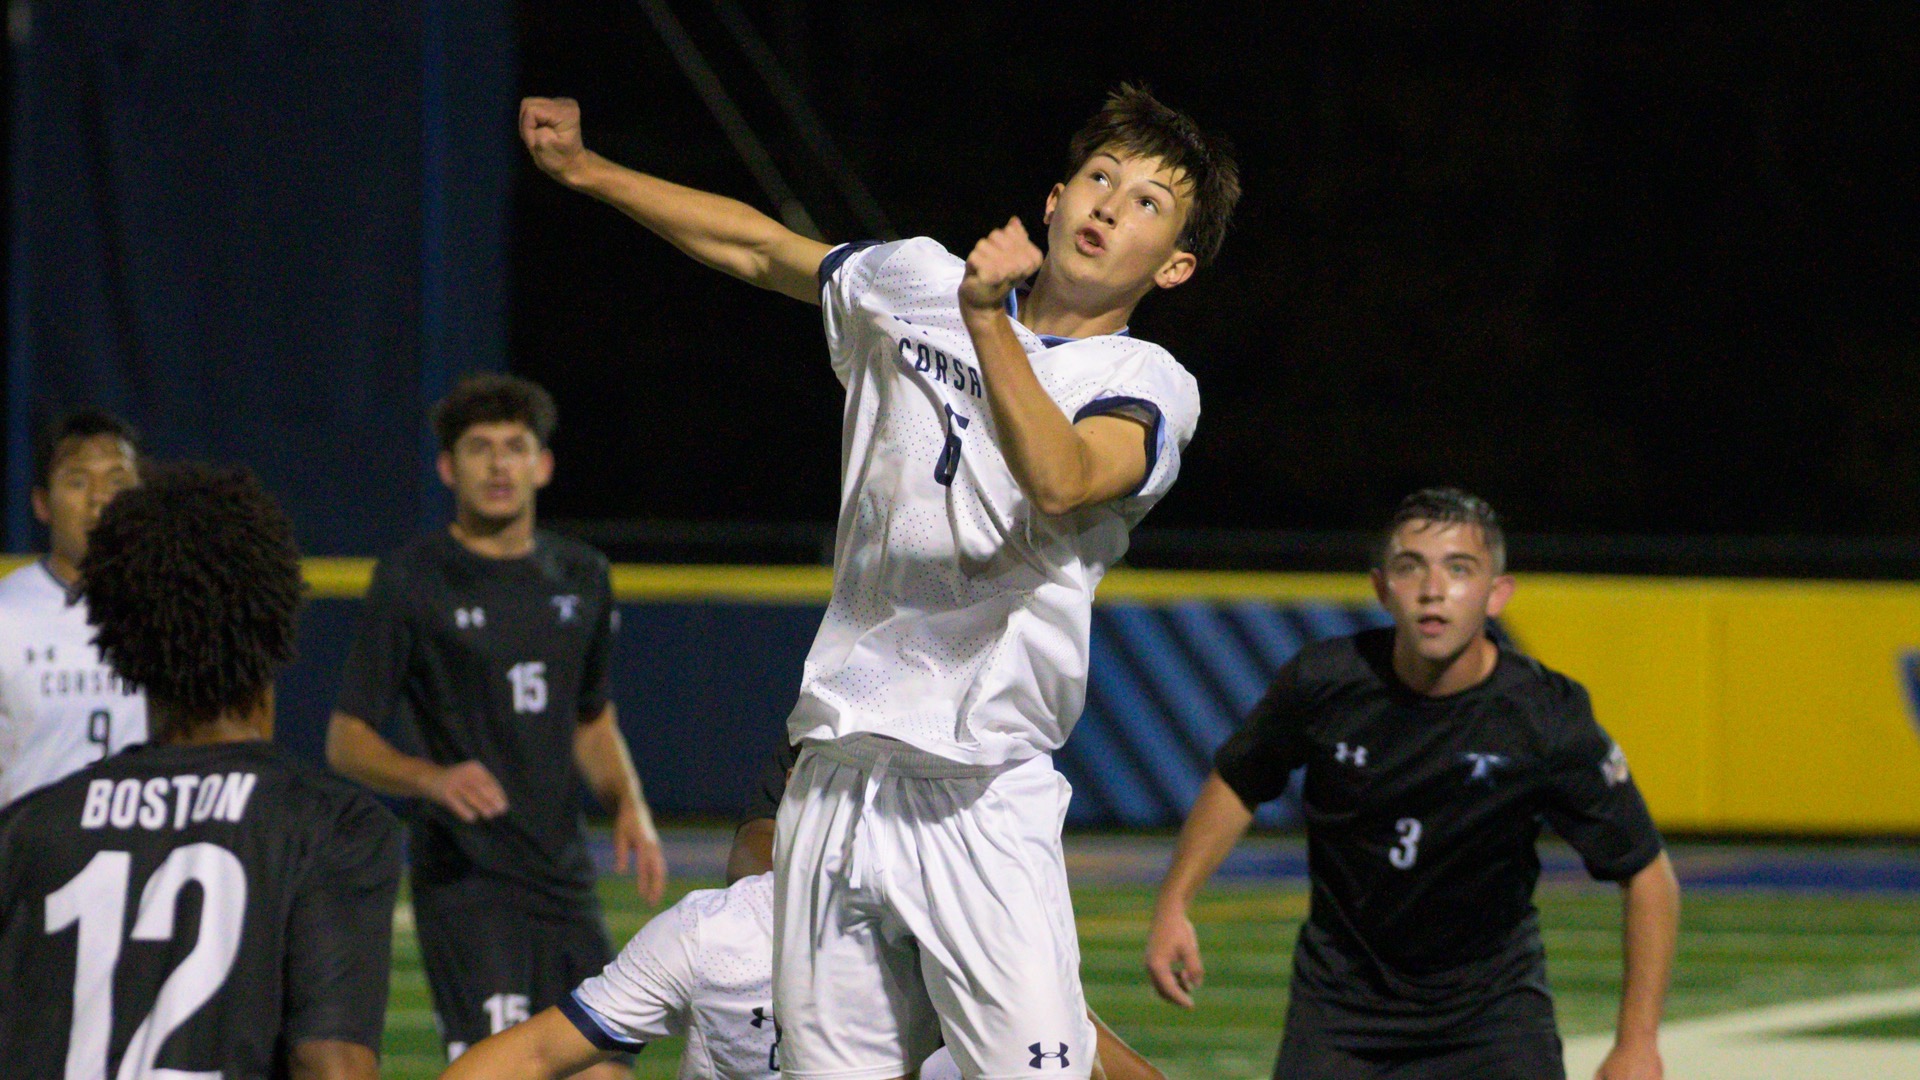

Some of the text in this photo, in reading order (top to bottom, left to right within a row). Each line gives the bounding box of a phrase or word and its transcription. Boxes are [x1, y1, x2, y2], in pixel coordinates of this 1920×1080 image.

[934, 403, 970, 487] 6
[507, 661, 548, 714] 15
[87, 709, 111, 758] 9
[81, 772, 256, 830] BOSTON
[1388, 817, 1422, 870] 3
[44, 842, 247, 1079] 12
